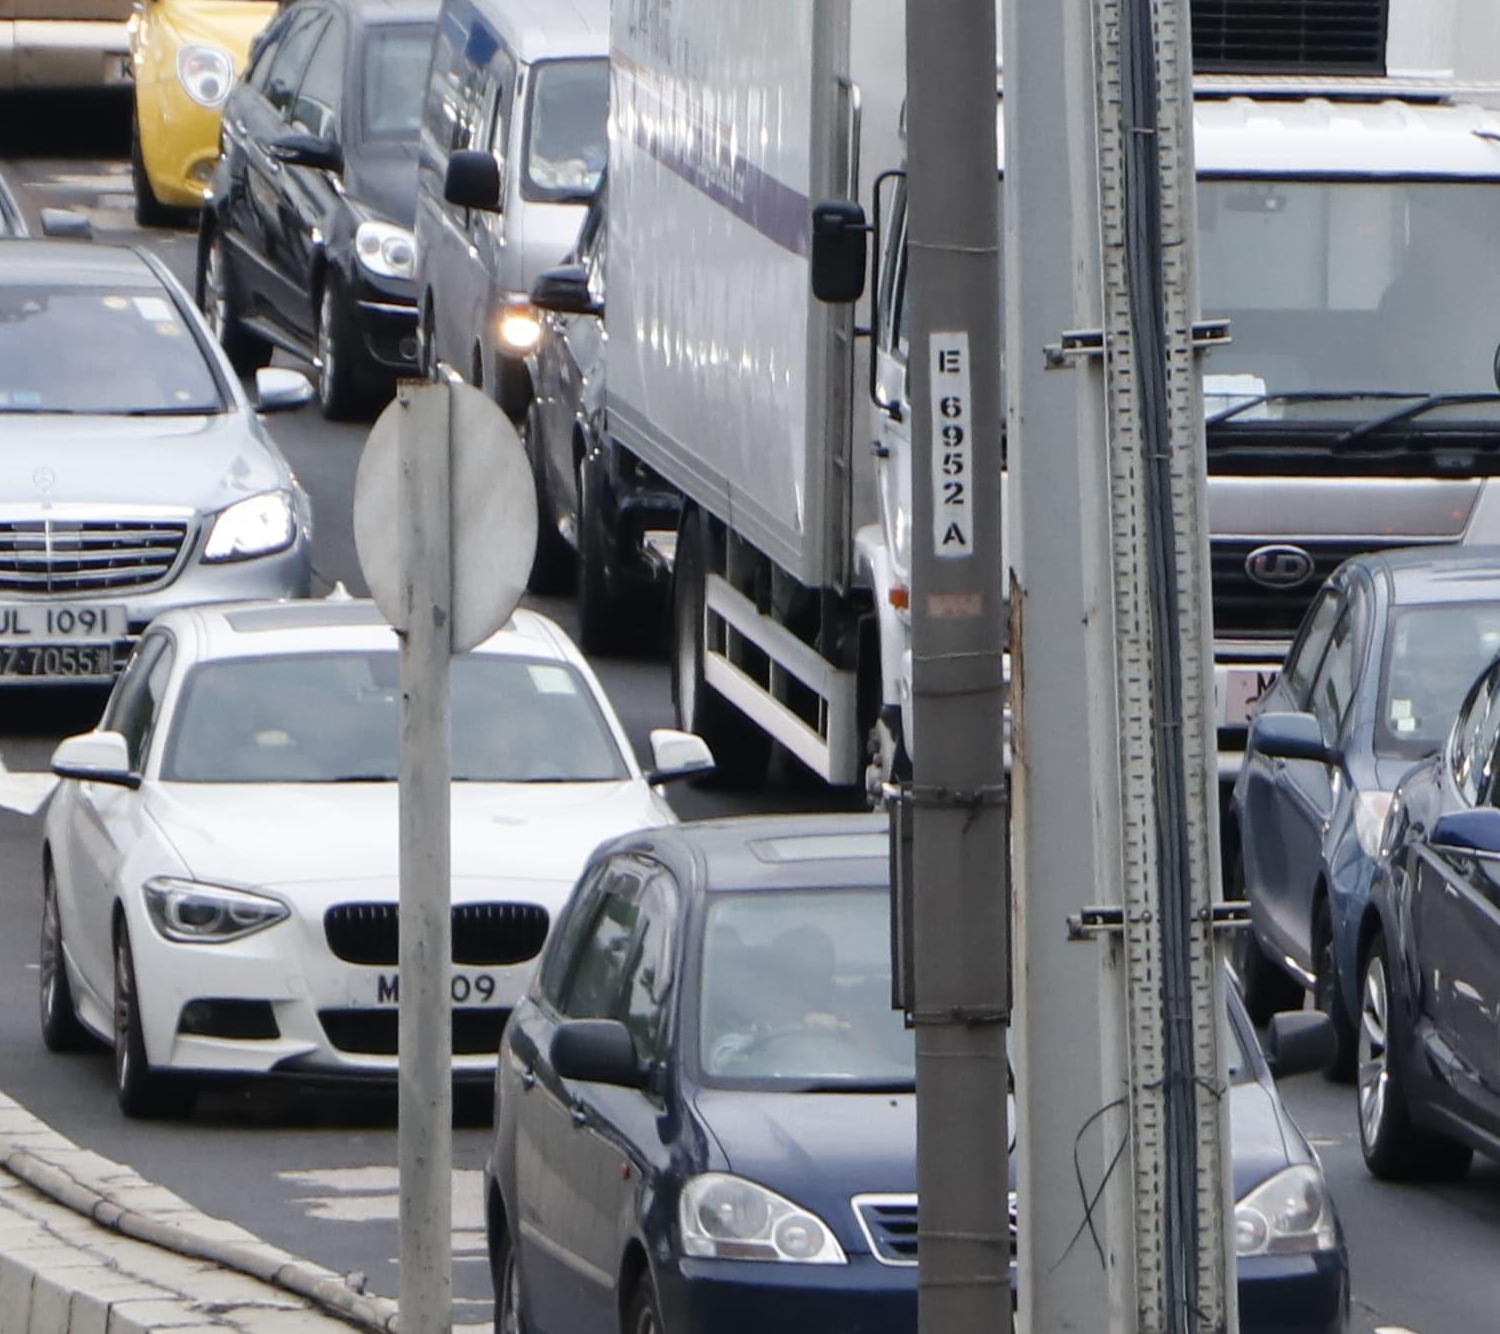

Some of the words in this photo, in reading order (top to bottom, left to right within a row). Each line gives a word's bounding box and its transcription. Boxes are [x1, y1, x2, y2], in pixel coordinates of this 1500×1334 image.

[938, 350, 960, 373] E
[939, 386, 965, 505] 6952
[941, 522, 966, 546] A
[47, 609, 107, 634] 1091
